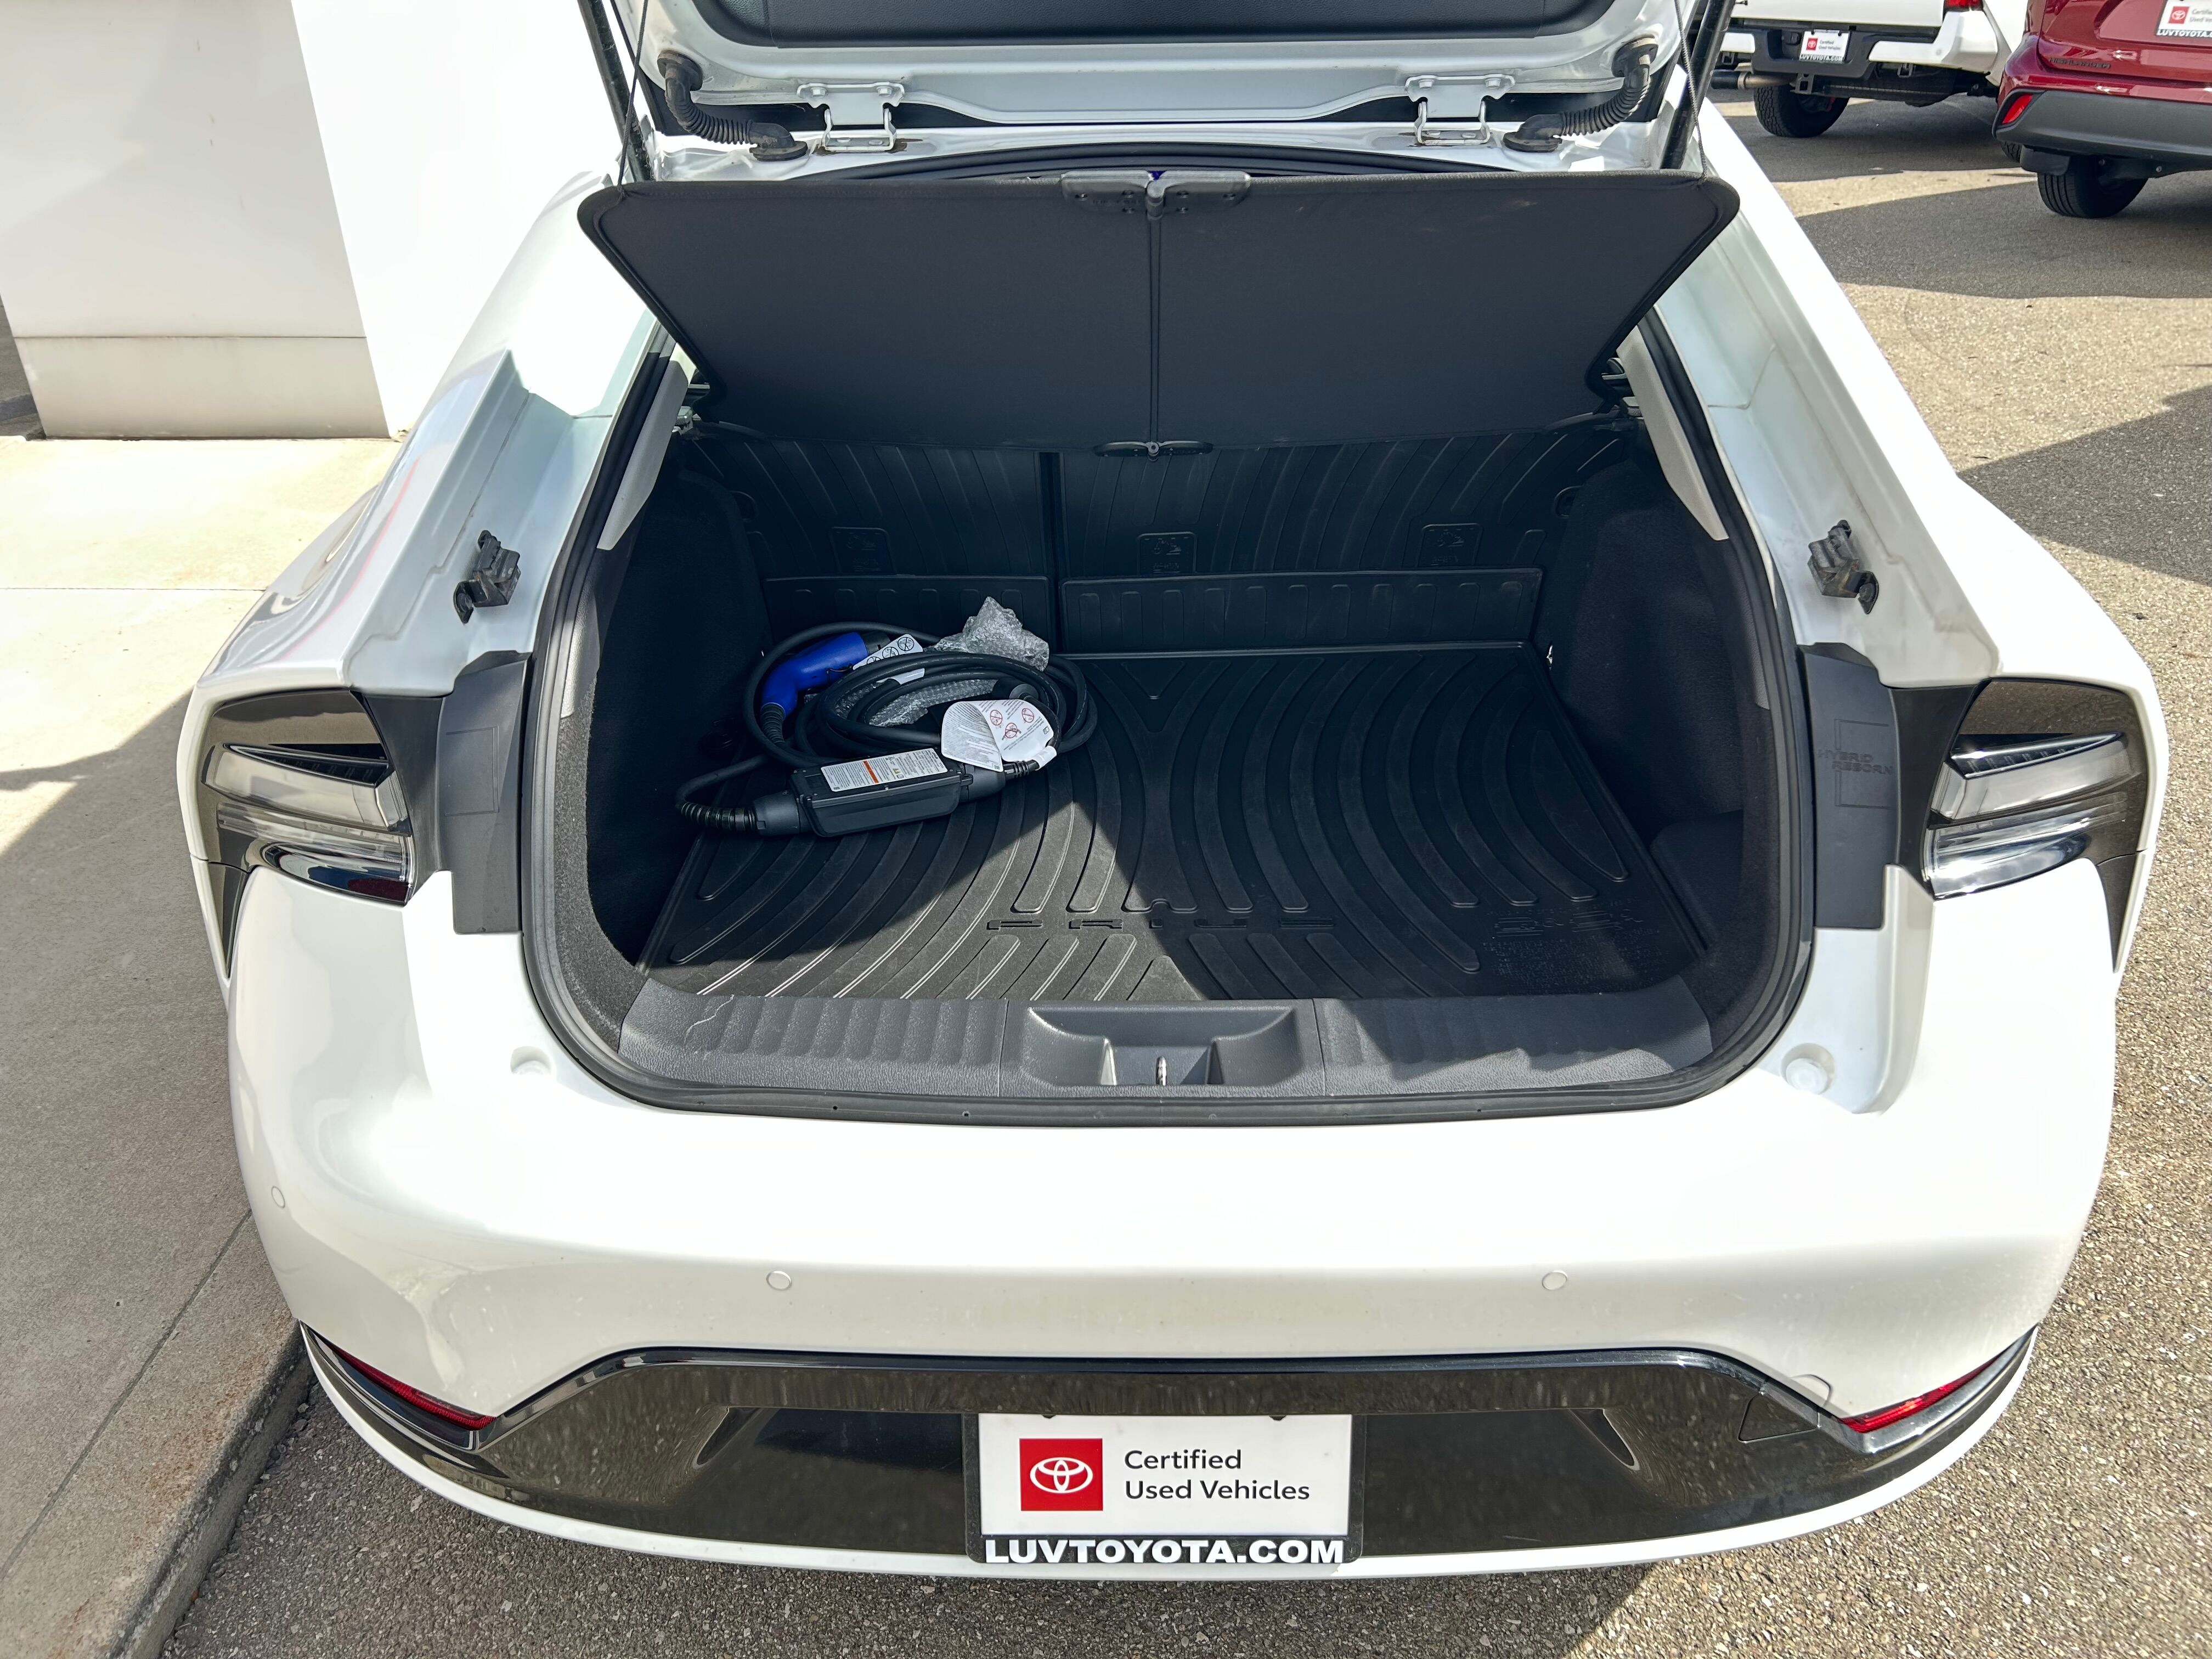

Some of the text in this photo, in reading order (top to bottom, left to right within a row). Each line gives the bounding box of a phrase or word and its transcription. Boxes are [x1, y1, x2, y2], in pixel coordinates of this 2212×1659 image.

[1124, 1449, 1242, 1469] Certified
[1125, 1479, 1311, 1500] Used Vehicles
[985, 1539, 1344, 1564] LUVTOYOTA.COM
